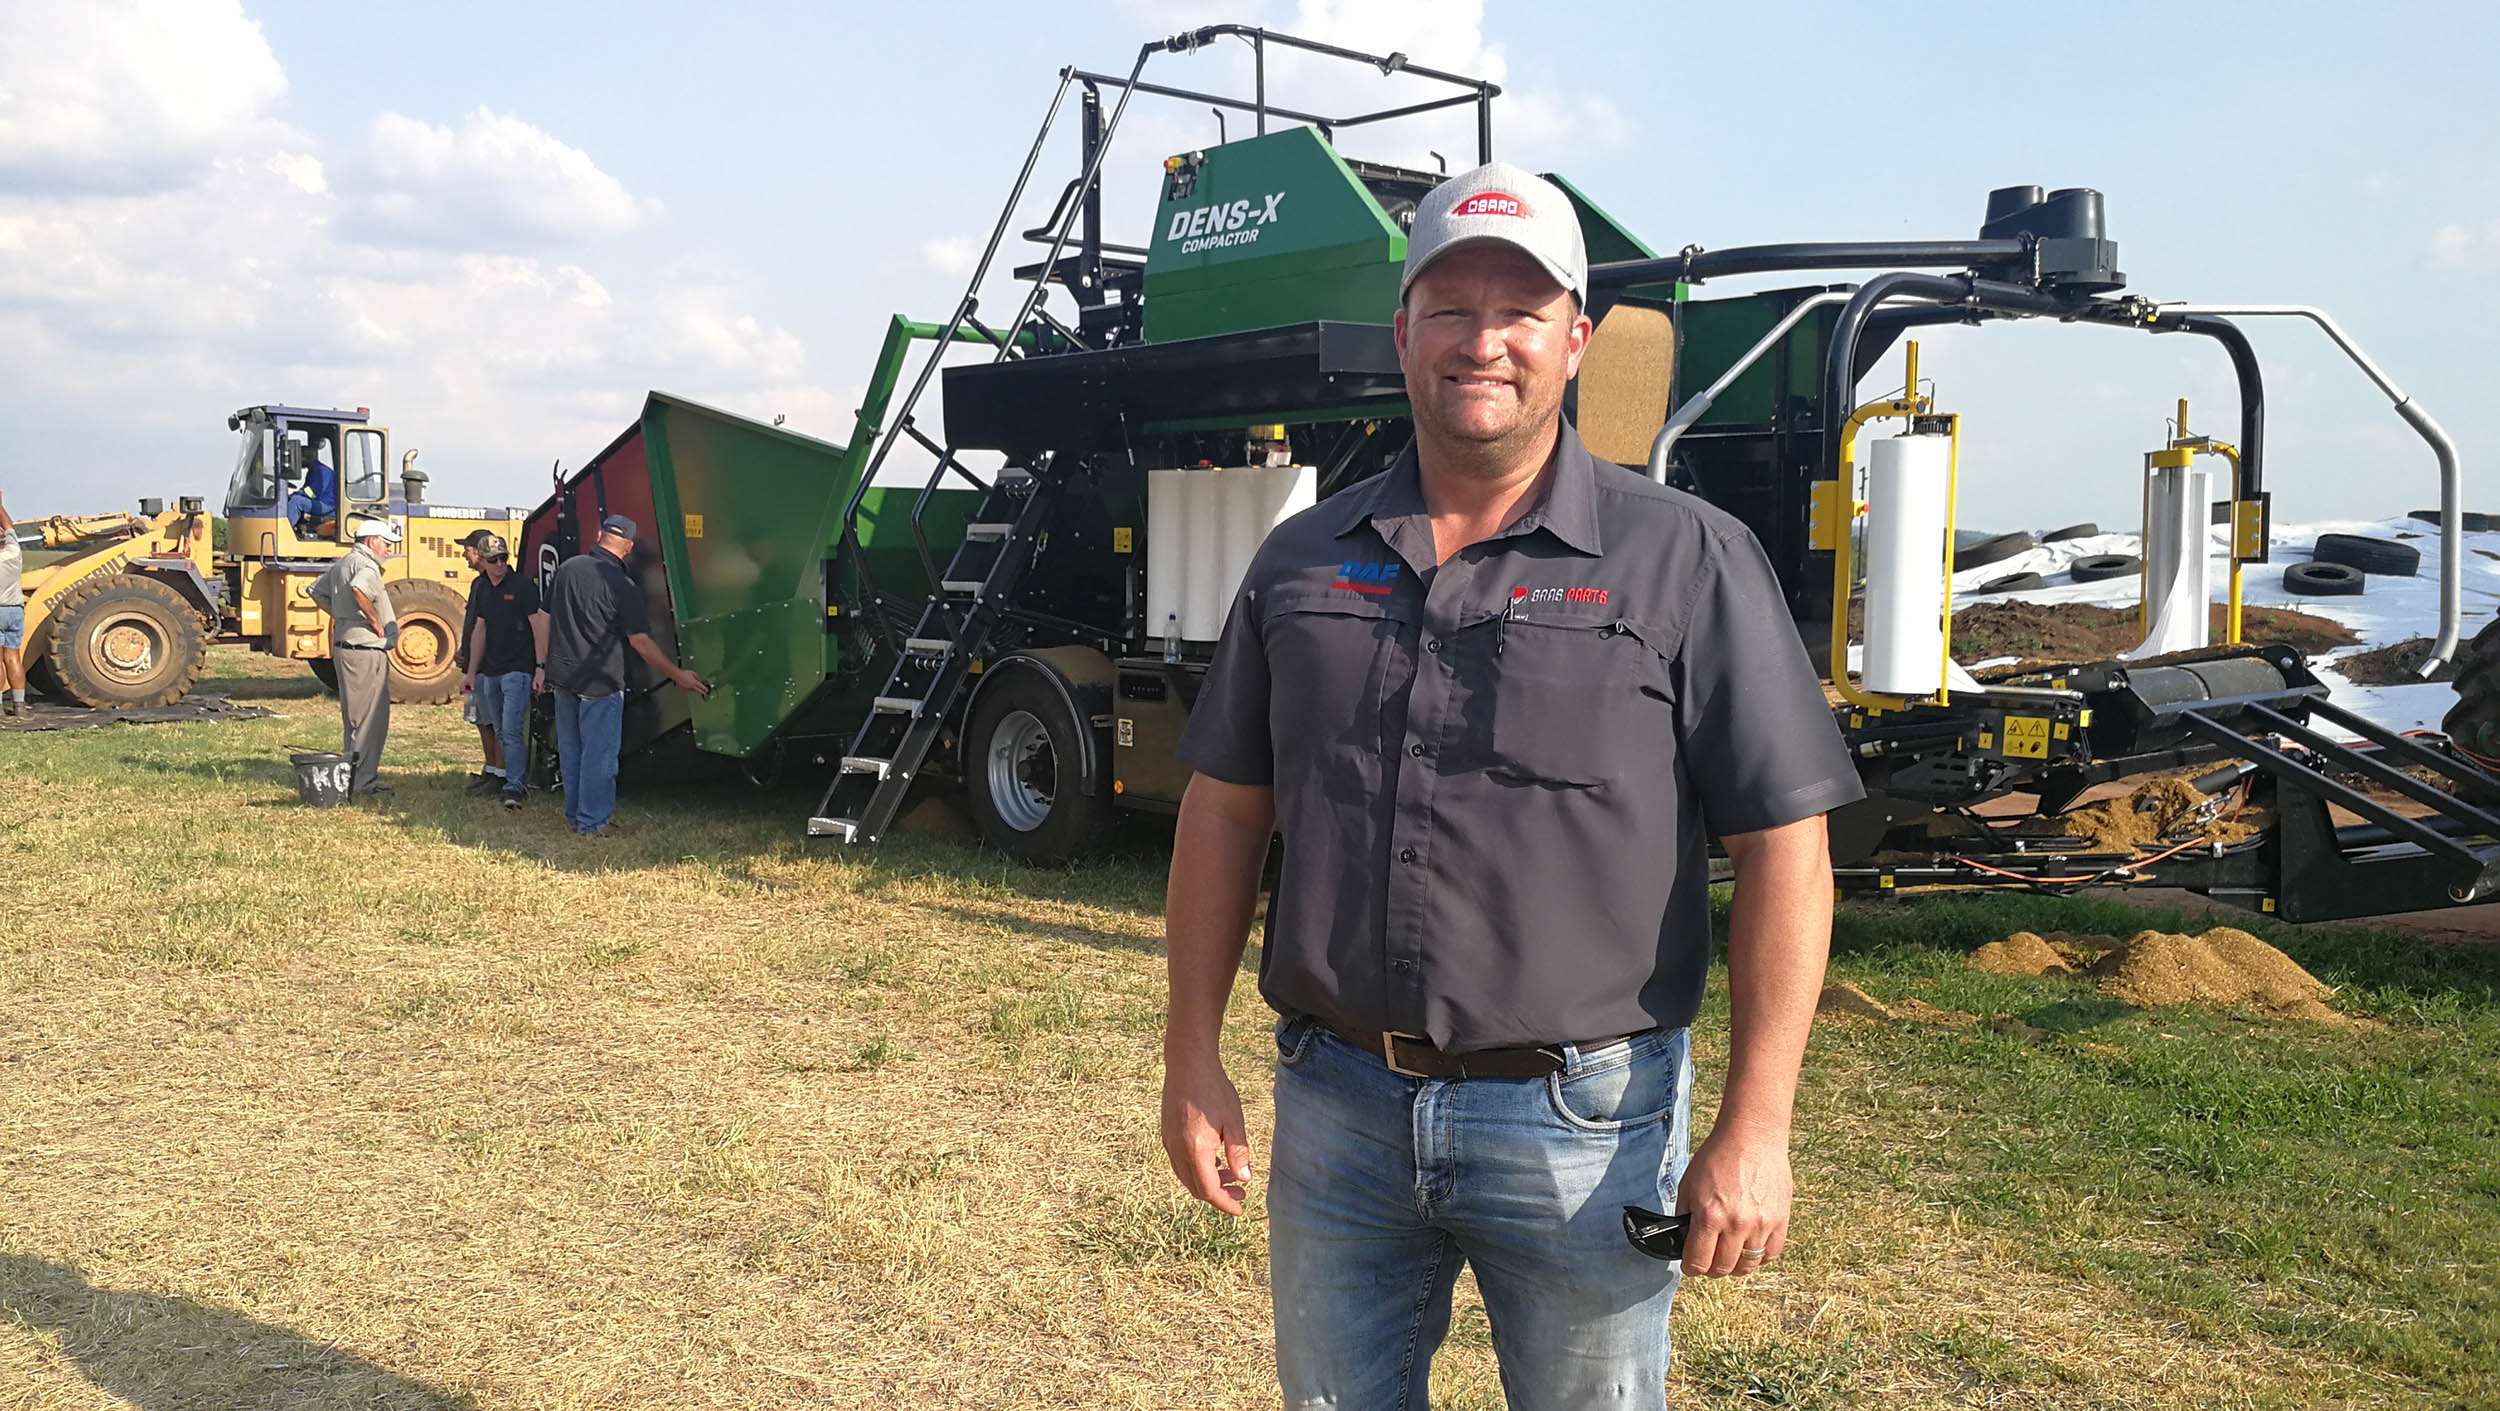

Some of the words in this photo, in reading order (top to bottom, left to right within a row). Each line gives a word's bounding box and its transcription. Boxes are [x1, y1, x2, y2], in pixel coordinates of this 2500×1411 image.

[1467, 199, 1518, 214] OBARO
[1168, 192, 1285, 241] DENS-X
[1182, 229, 1259, 253] COMPACTOR
[429, 507, 487, 519] RONDEBULT
[1338, 561, 1400, 582] DAF
[1566, 588, 1608, 605] PARTS
